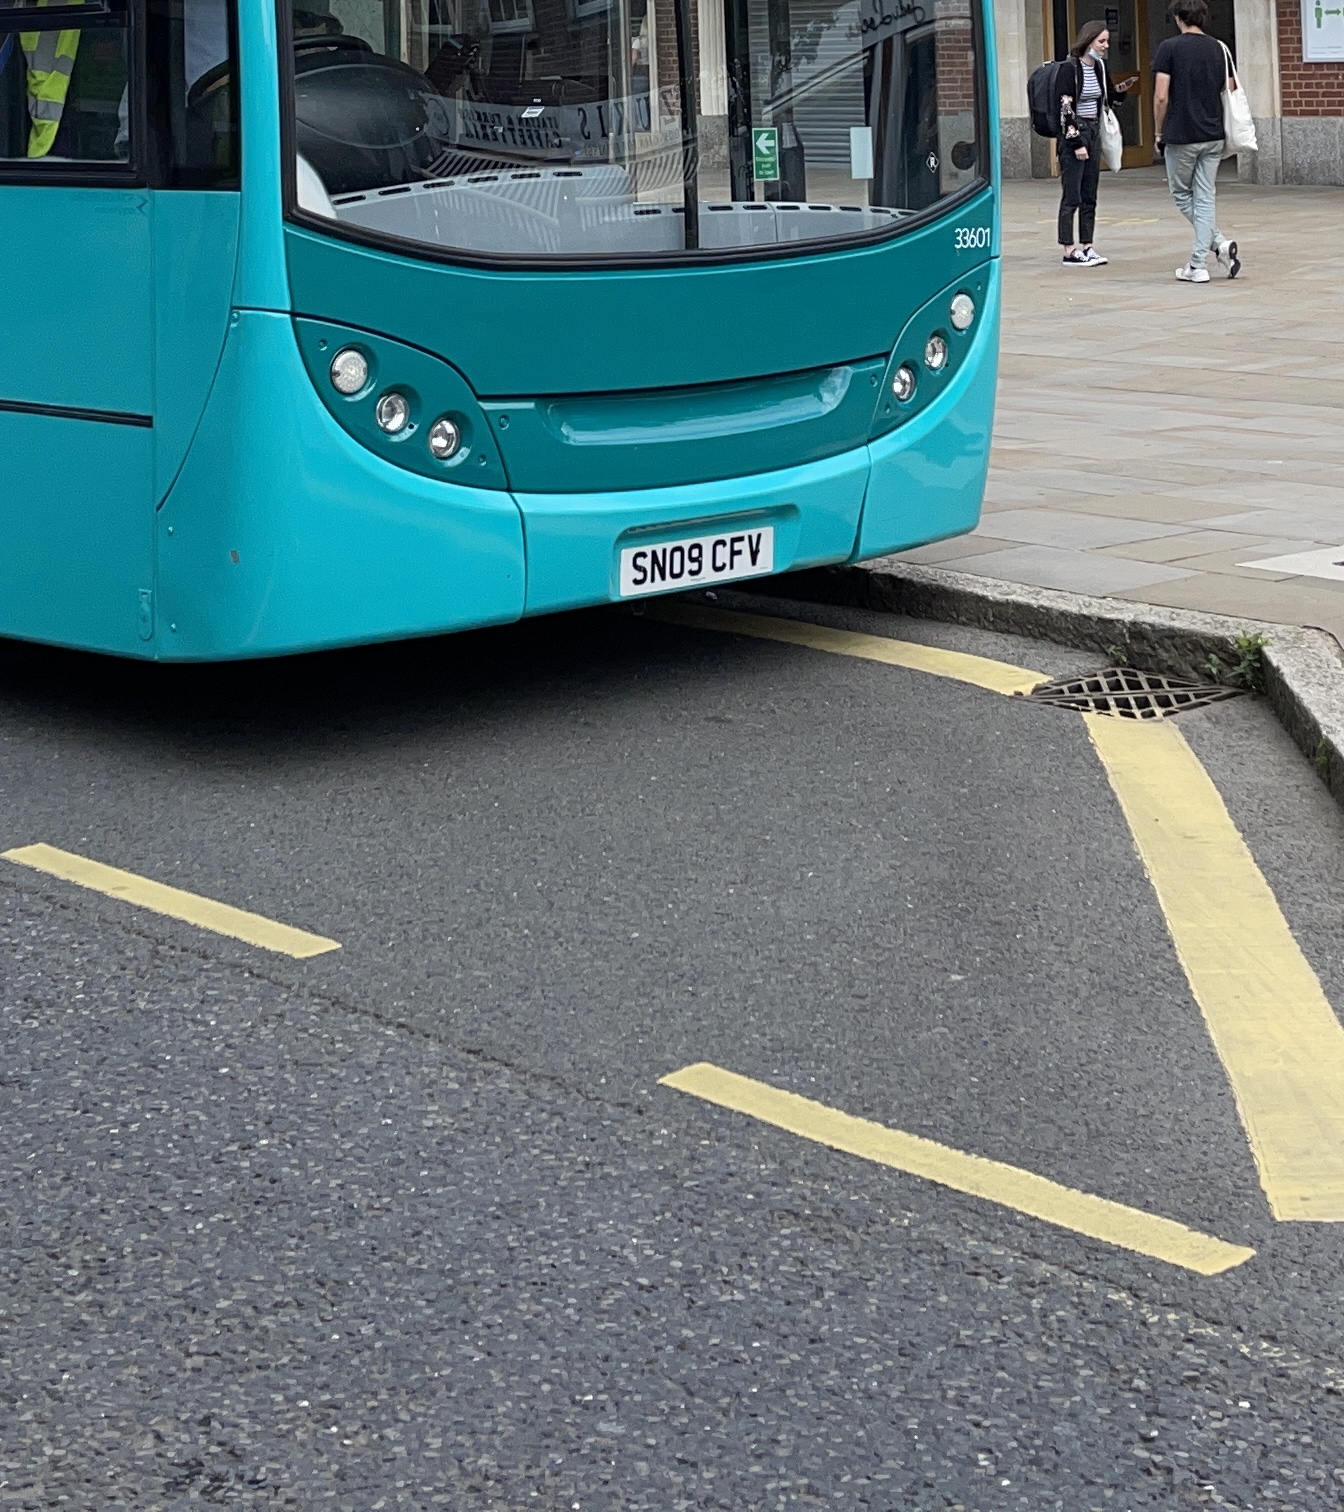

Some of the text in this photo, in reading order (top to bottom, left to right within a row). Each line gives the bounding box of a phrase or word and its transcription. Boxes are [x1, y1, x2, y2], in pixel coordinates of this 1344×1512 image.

[954, 227, 991, 248] 33601
[632, 533, 762, 585] SN09 CFV
